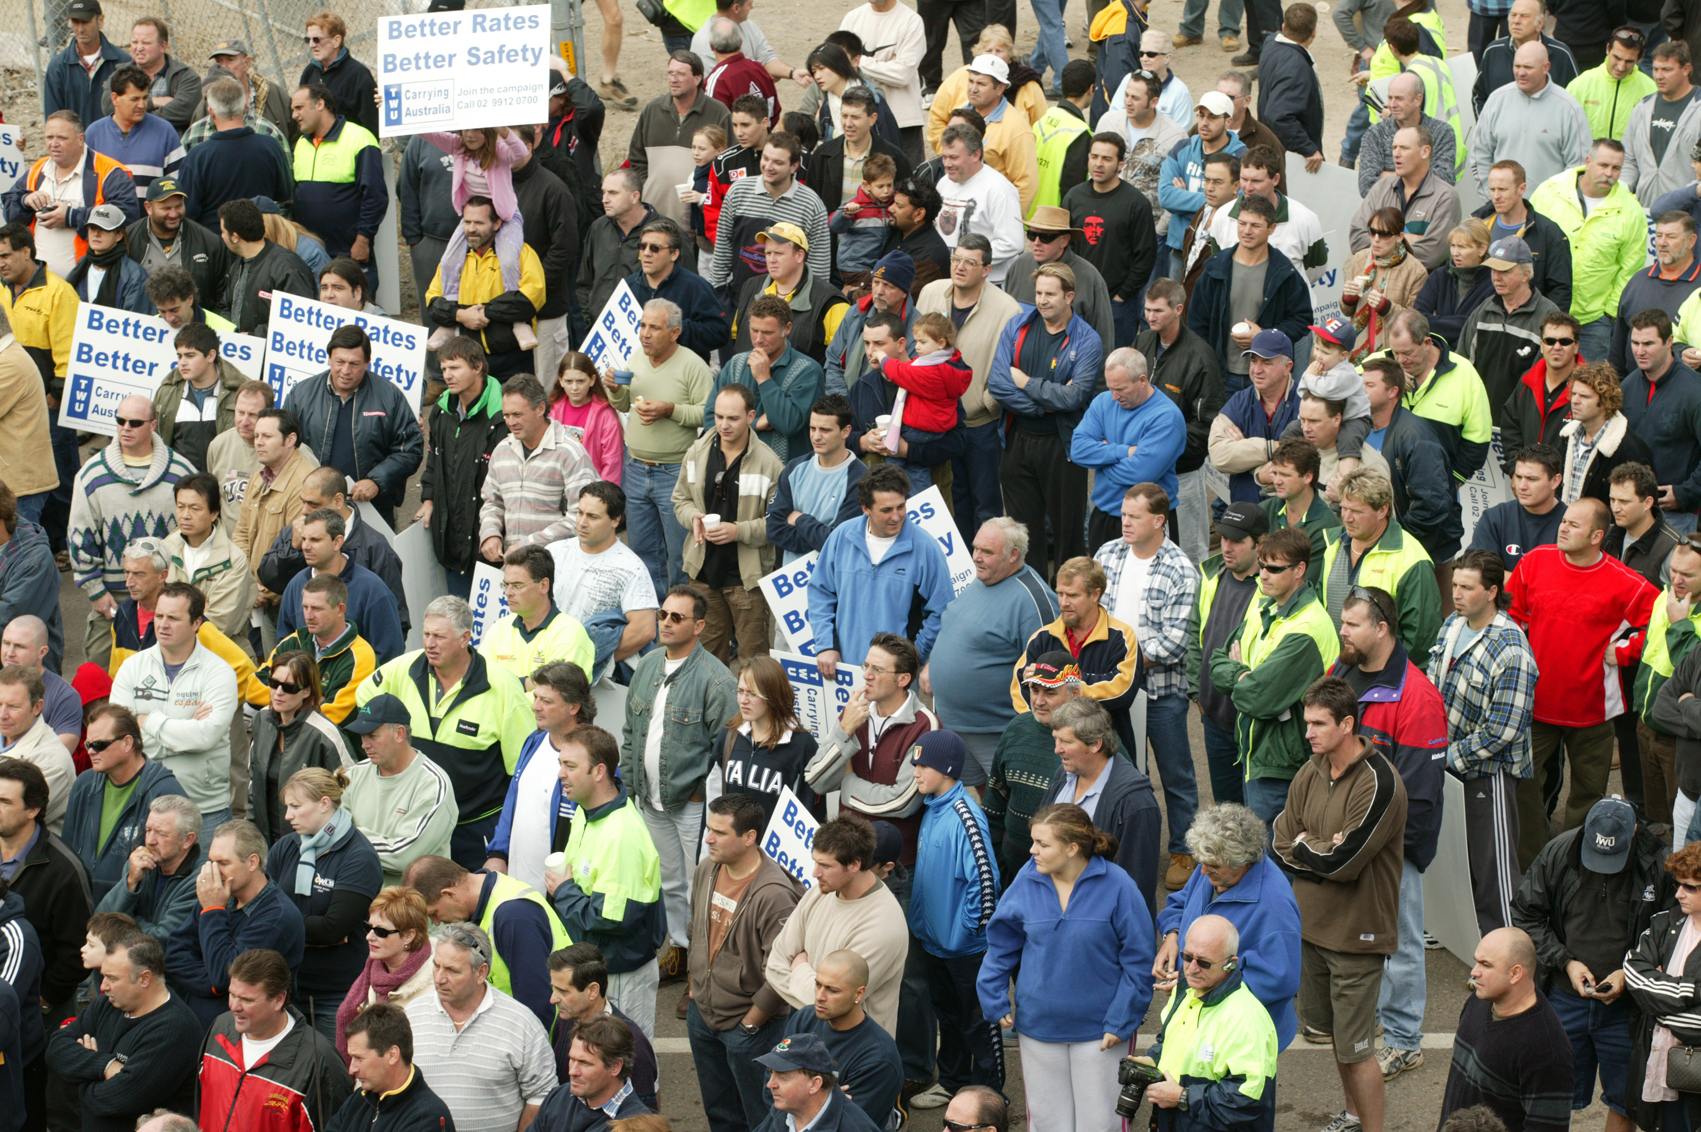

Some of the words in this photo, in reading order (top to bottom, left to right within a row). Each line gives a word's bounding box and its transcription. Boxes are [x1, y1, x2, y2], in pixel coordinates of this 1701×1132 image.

[388, 18, 462, 40] Better
[472, 12, 540, 33] Rates
[383, 51, 457, 73] Better
[466, 43, 544, 67] Safety
[404, 87, 449, 101] Carrying
[457, 87, 478, 97] Join
[480, 85, 495, 95] the
[497, 83, 544, 95] campaign
[389, 88, 399, 120] TWU
[404, 104, 451, 118] Australia
[457, 100, 475, 110] Call
[477, 99, 488, 109] 02
[492, 97, 514, 107] 9912
[516, 95, 538, 105] 0700
[87, 309, 169, 343] Better
[271, 331, 330, 365] Bette
[75, 342, 159, 377] Better
[75, 379, 88, 413] TWU
[1469, 486, 1479, 506] Call
[1480, 488, 1488, 509] Join
[1471, 507, 1480, 518] 02
[1595, 833, 1616, 848] TWU
